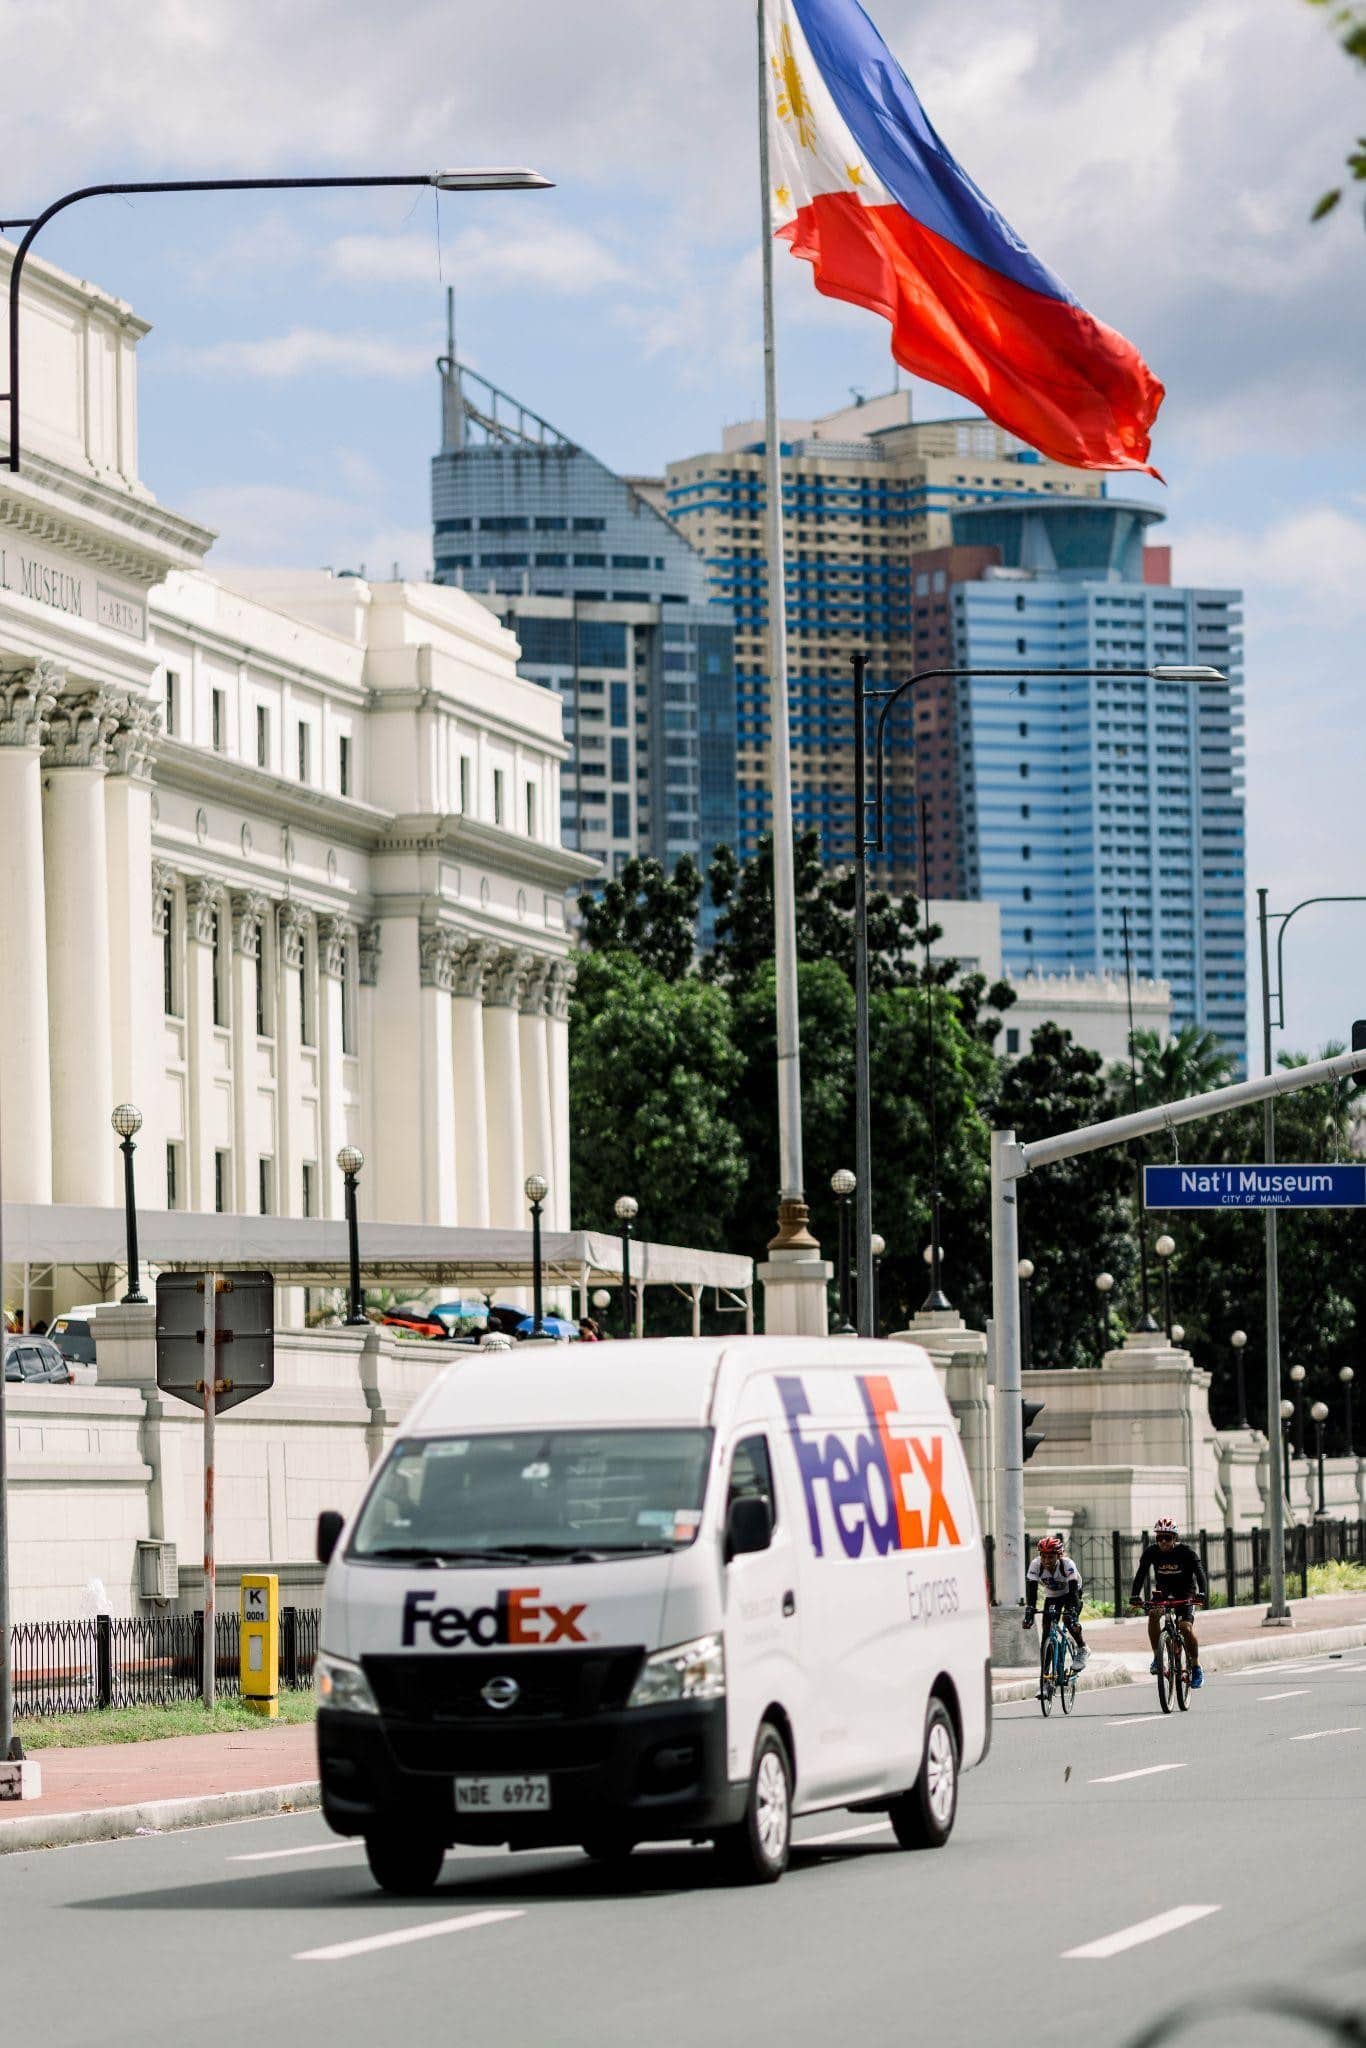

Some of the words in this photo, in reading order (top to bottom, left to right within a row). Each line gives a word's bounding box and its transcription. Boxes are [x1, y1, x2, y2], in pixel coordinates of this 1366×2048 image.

[20, 556, 82, 617] MUSEUM
[1181, 1171, 1232, 1192] Nat'l
[1239, 1171, 1333, 1192] Museum
[1221, 1195, 1241, 1204] CITY
[1245, 1195, 1257, 1204] OF
[1260, 1195, 1291, 1204] MANILA
[773, 1374, 961, 1558] FedEx
[249, 1590, 262, 1604] K
[906, 1570, 960, 1629] Express
[246, 1611, 265, 1620] 0001
[402, 1588, 589, 1648] FedEx
[458, 1785, 490, 1804] NDE
[503, 1784, 546, 1803] 6972
